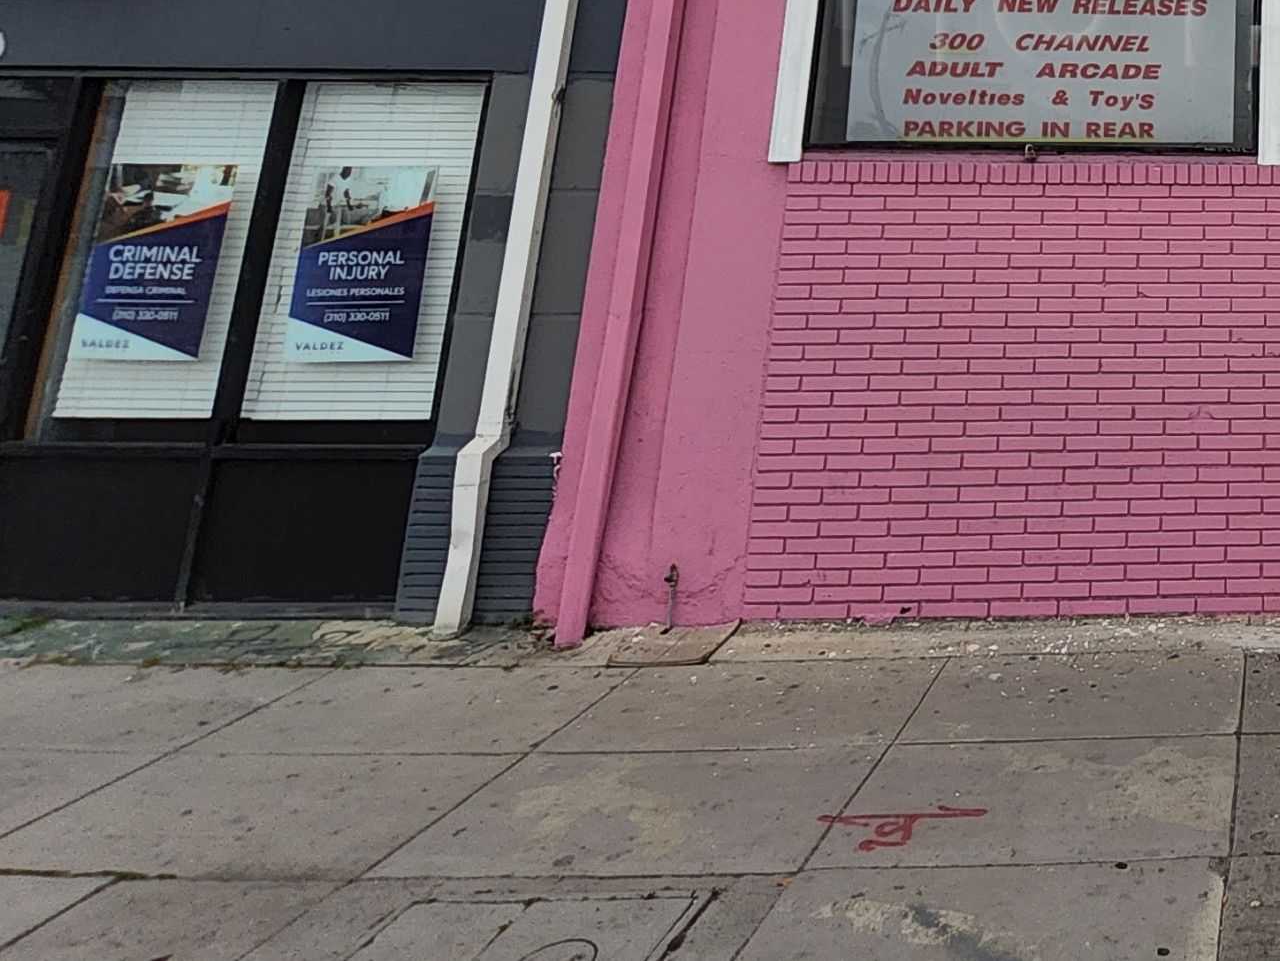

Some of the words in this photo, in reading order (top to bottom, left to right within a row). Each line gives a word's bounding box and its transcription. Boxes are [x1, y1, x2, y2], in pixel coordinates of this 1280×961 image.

[929, 33, 985, 51] 300
[1015, 33, 1150, 52] CHANNEL
[906, 61, 1004, 79] ADULT
[1036, 62, 1162, 80] ARCADE
[903, 88, 1025, 106] Novelties
[1051, 89, 1069, 106] &
[904, 120, 1026, 138] PARKING
[1042, 121, 1070, 139] IN
[1085, 121, 1155, 139] REAR
[108, 244, 203, 263] CRIMINAL
[317, 249, 405, 266] PERSONAL
[108, 263, 195, 280] DEFENSE
[329, 265, 391, 280] INJURY
[306, 287, 348, 298] LESIONES
[349, 286, 405, 297] PERSONALES
[323, 312, 347, 323] (310)
[348, 311, 390, 323] 330-0511
[295, 341, 345, 351] VALDEZ
